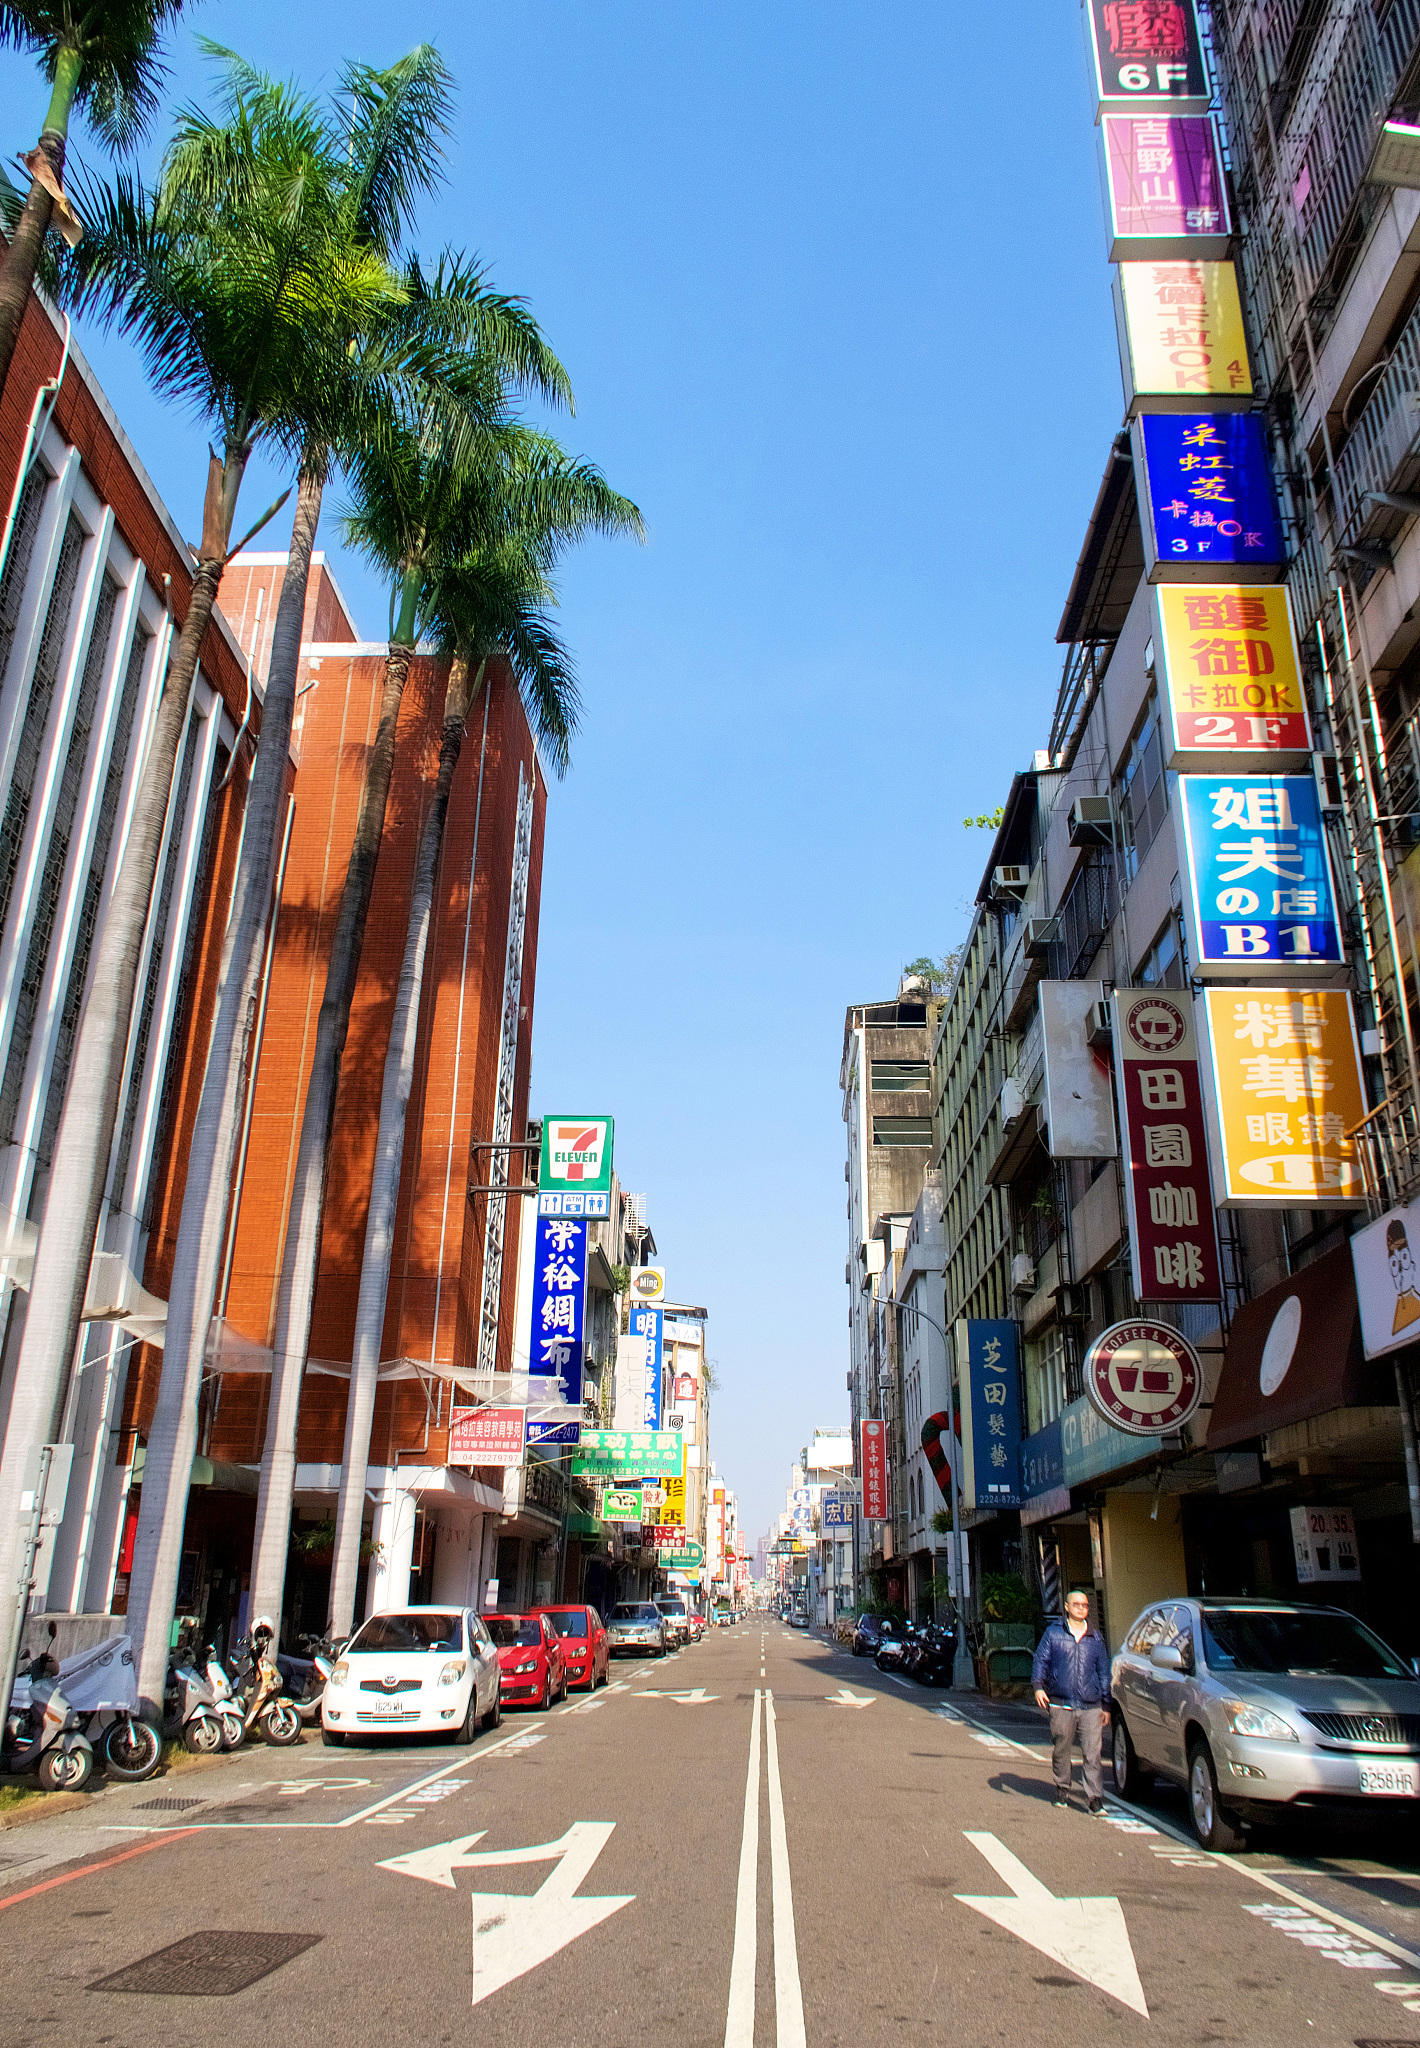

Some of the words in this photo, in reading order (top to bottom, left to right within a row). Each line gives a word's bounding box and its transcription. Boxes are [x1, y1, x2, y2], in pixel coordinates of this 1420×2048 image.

[1118, 62, 1188, 91] 6F
[1132, 120, 1177, 203] 吉野山
[1186, 210, 1219, 228] 5F
[1160, 499, 1265, 547] 卡拉OK
[1183, 594, 1276, 676] 馥御
[1182, 683, 1295, 708] 卡拉OK
[1194, 716, 1289, 743] 2F
[1220, 925, 1320, 955] B1
[1132, 1000, 1156, 1015] COFFEE
[1165, 1003, 1177, 1016] TEA
[1233, 1000, 1335, 1103] 精華
[1246, 1112, 1348, 1146] 眼鏡
[558, 1127, 598, 1179] 7
[1137, 1069, 1205, 1289] 田園咖啡
[1266, 1160, 1341, 1184] 1F
[639, 1277, 659, 1290] Ming
[540, 1220, 582, 1405] 榮裕綢布
[1105, 1328, 1147, 1354] COFFEE
[1152, 1330, 1159, 1341] &
[1163, 1336, 1184, 1358] TEA
[678, 1379, 696, 1398] 通
[981, 1337, 1008, 1467] 芝田髮藝
[868, 1441, 881, 1517] 臺中鐘錶眼鏡
